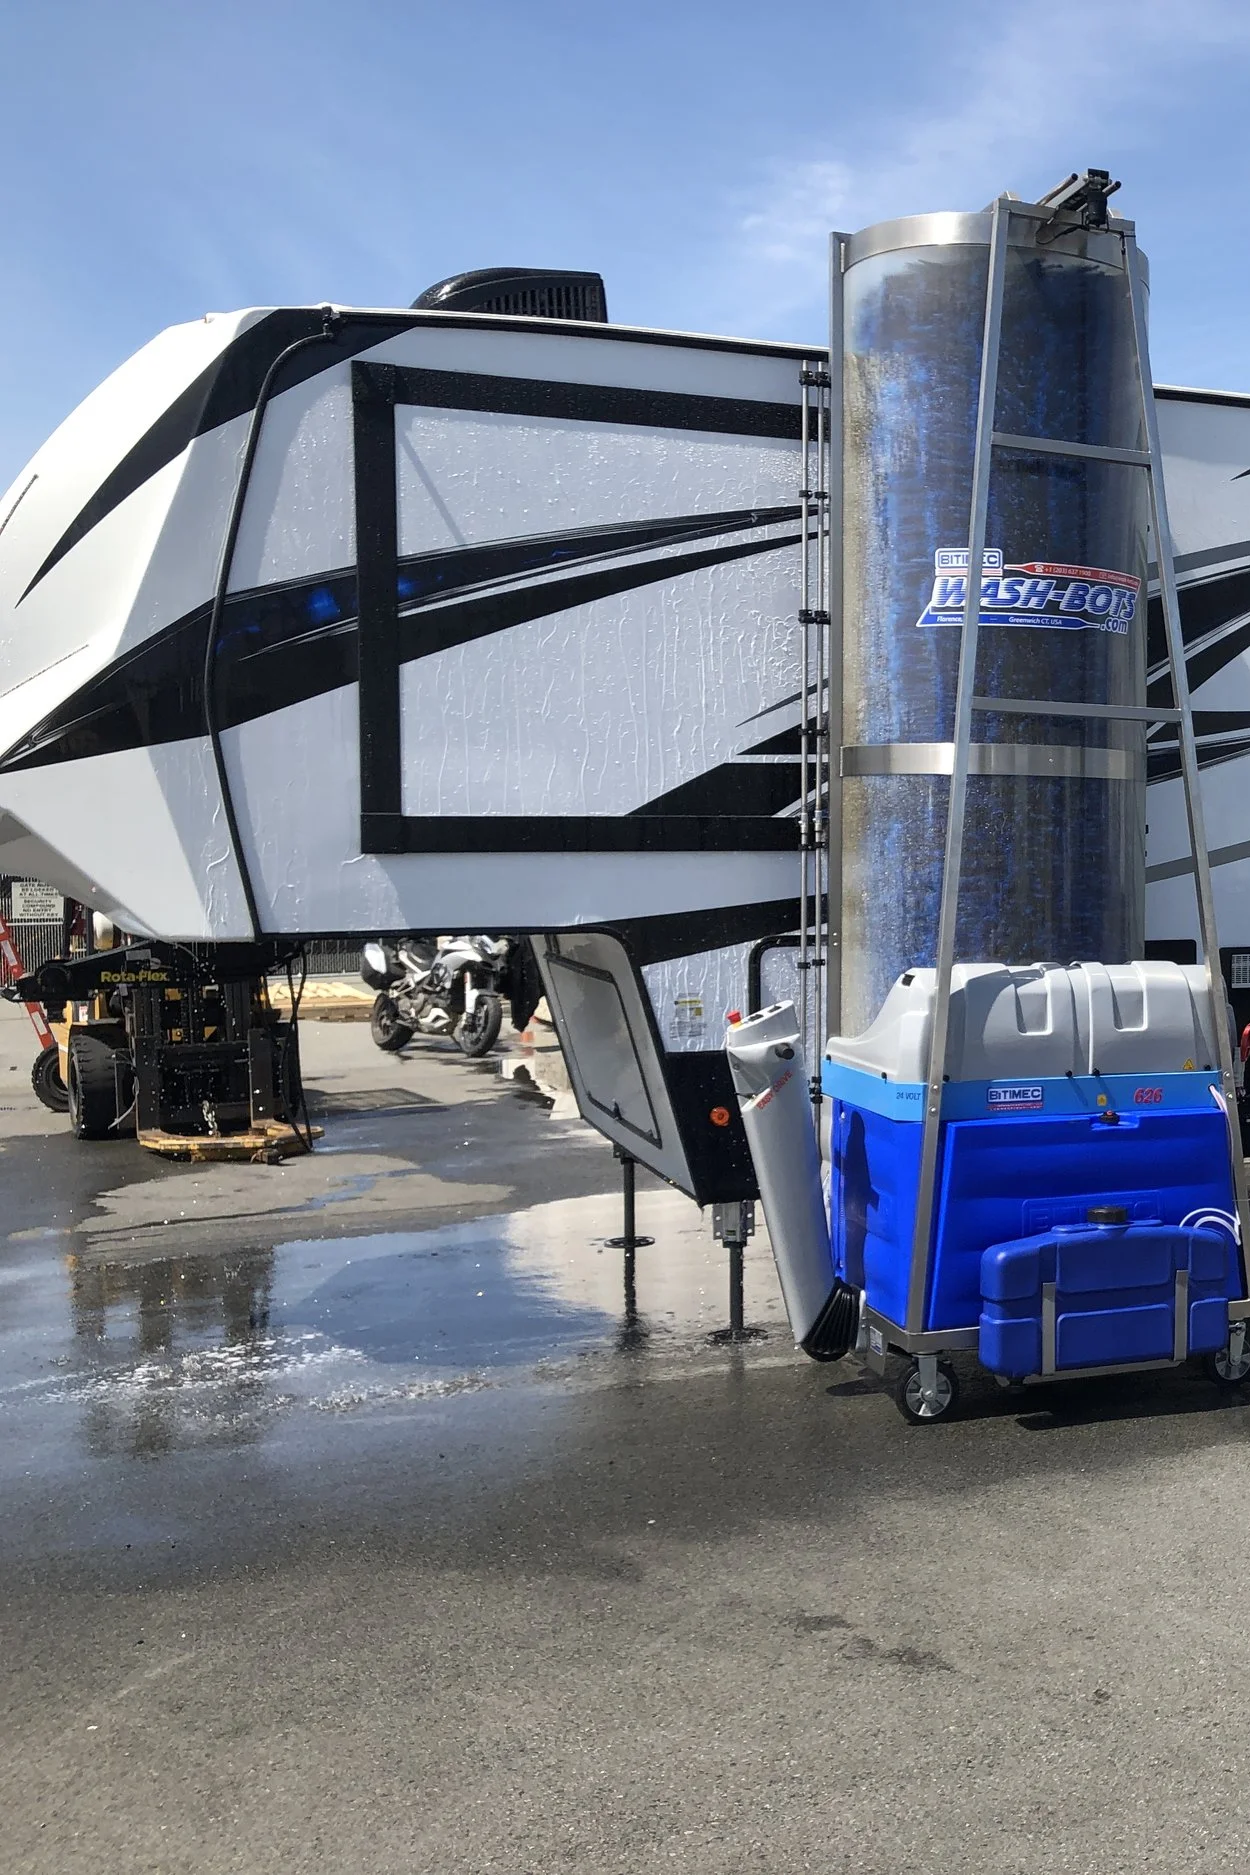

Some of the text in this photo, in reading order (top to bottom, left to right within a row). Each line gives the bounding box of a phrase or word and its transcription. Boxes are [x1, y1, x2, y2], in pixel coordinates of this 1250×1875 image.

[940, 553, 998, 565] BITIC
[935, 577, 1137, 620] WASH-BOTS
[1008, 616, 1041, 624] Greenwich
[1100, 617, 1128, 635] .com
[896, 1091, 921, 1101] 24 VOLT
[1133, 1087, 1163, 1105] 626
